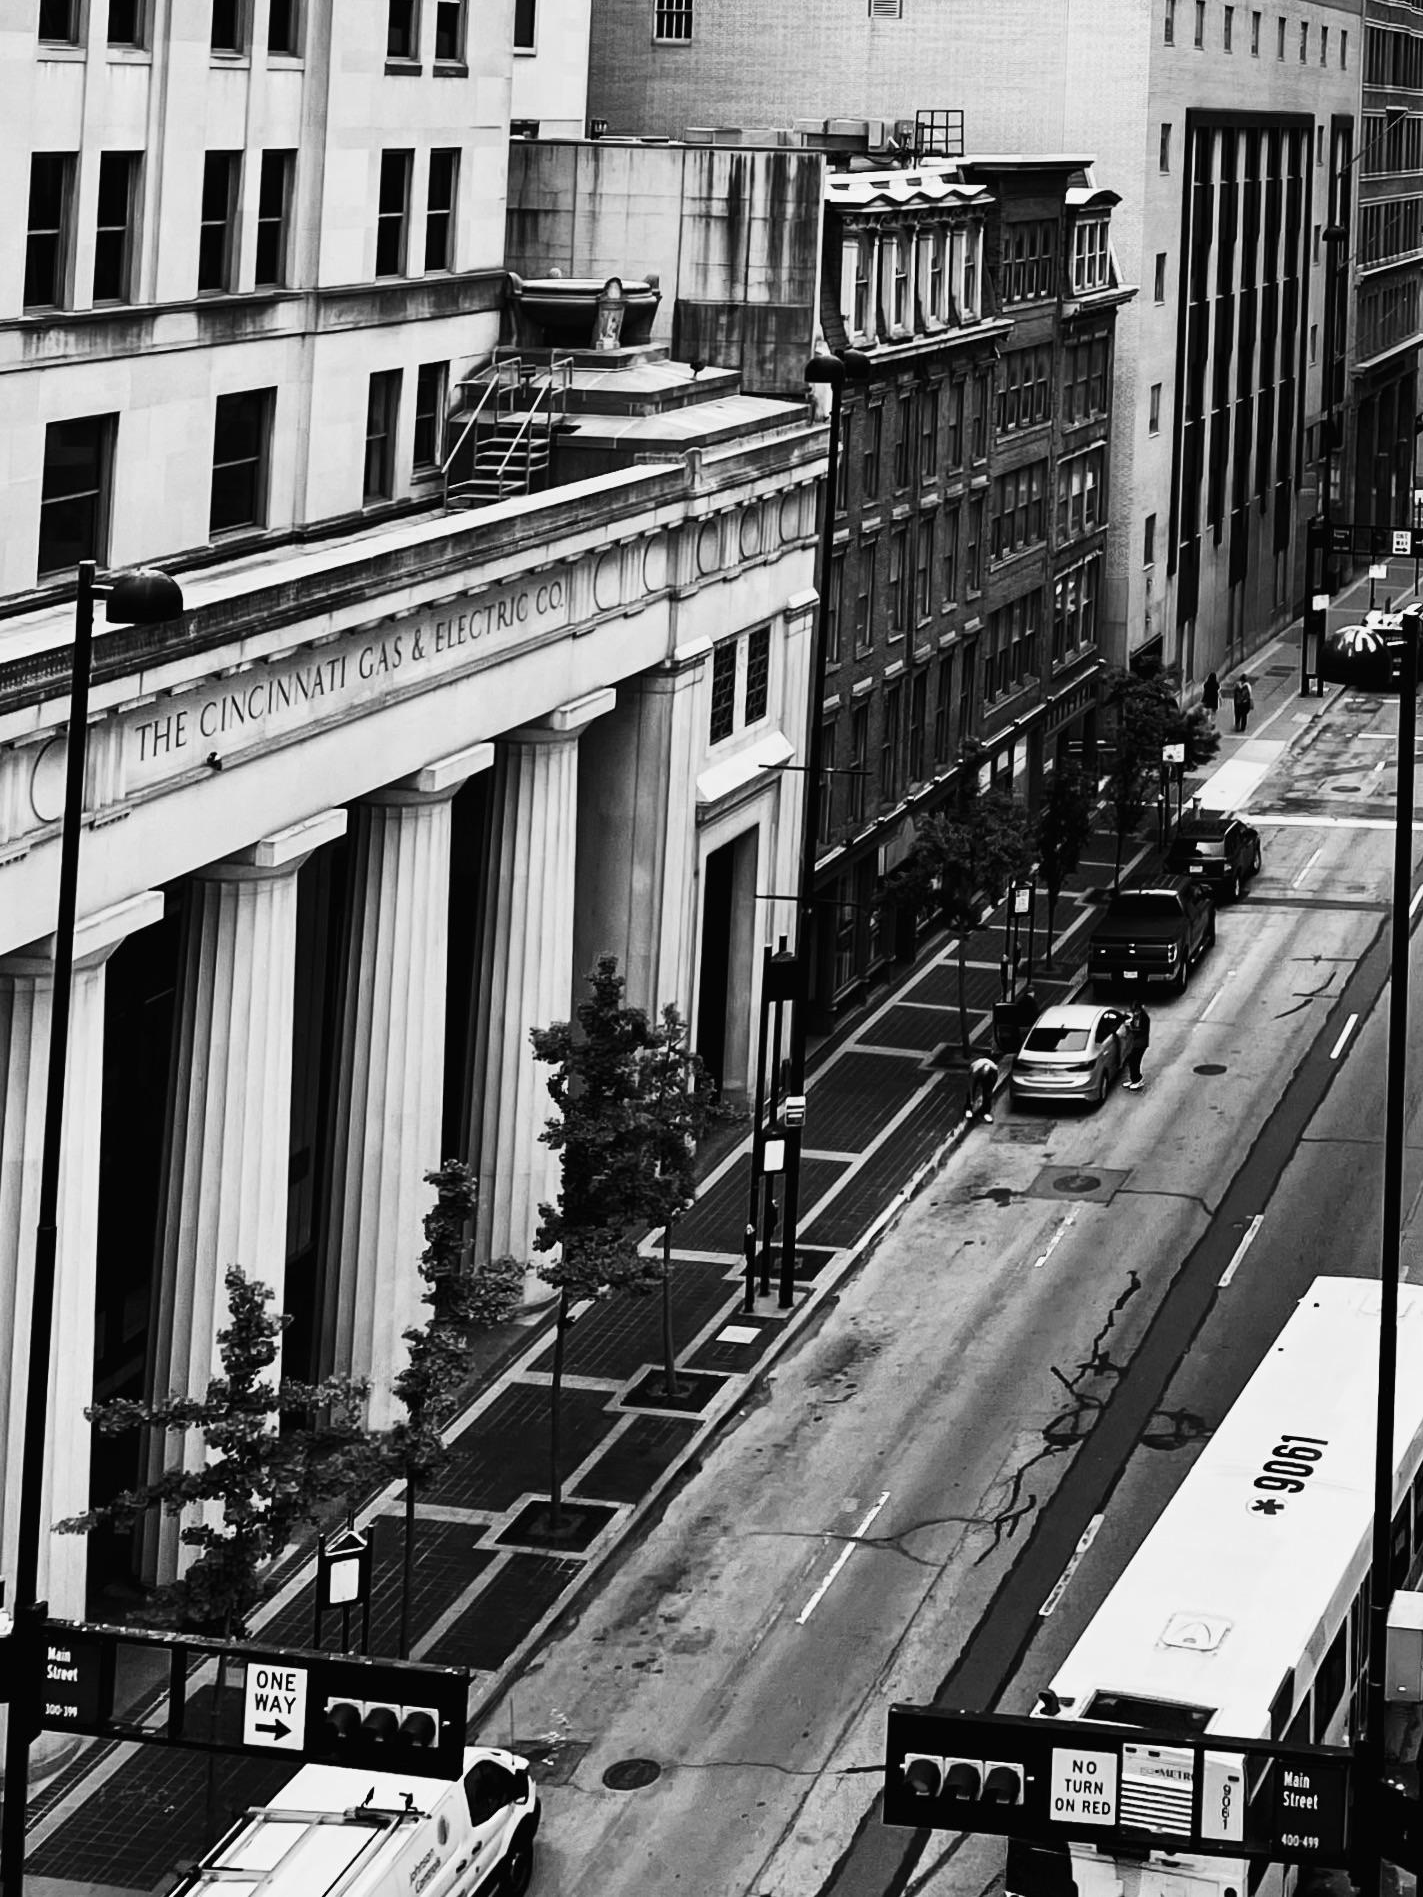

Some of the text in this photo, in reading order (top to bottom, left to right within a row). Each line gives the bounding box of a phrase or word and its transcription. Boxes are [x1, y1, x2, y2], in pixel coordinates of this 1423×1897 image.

[135, 581, 564, 761] THE CINCINNATI GAS & ELECTRIC CO.
[1254, 1435, 1329, 1493] 9061
[47, 1646, 72, 1663] Main
[46, 1663, 78, 1682] Street
[256, 1670, 297, 1692] ONE
[254, 1693, 297, 1715] WAY
[1072, 1759, 1097, 1775] NO
[1064, 1778, 1104, 1795] TURN
[1283, 1771, 1310, 1789] Main
[1054, 1797, 1111, 1816] ON RED
[1221, 1784, 1232, 1830] 9061
[1282, 1790, 1319, 1810] Street
[1281, 1833, 1319, 1849] 400-499
